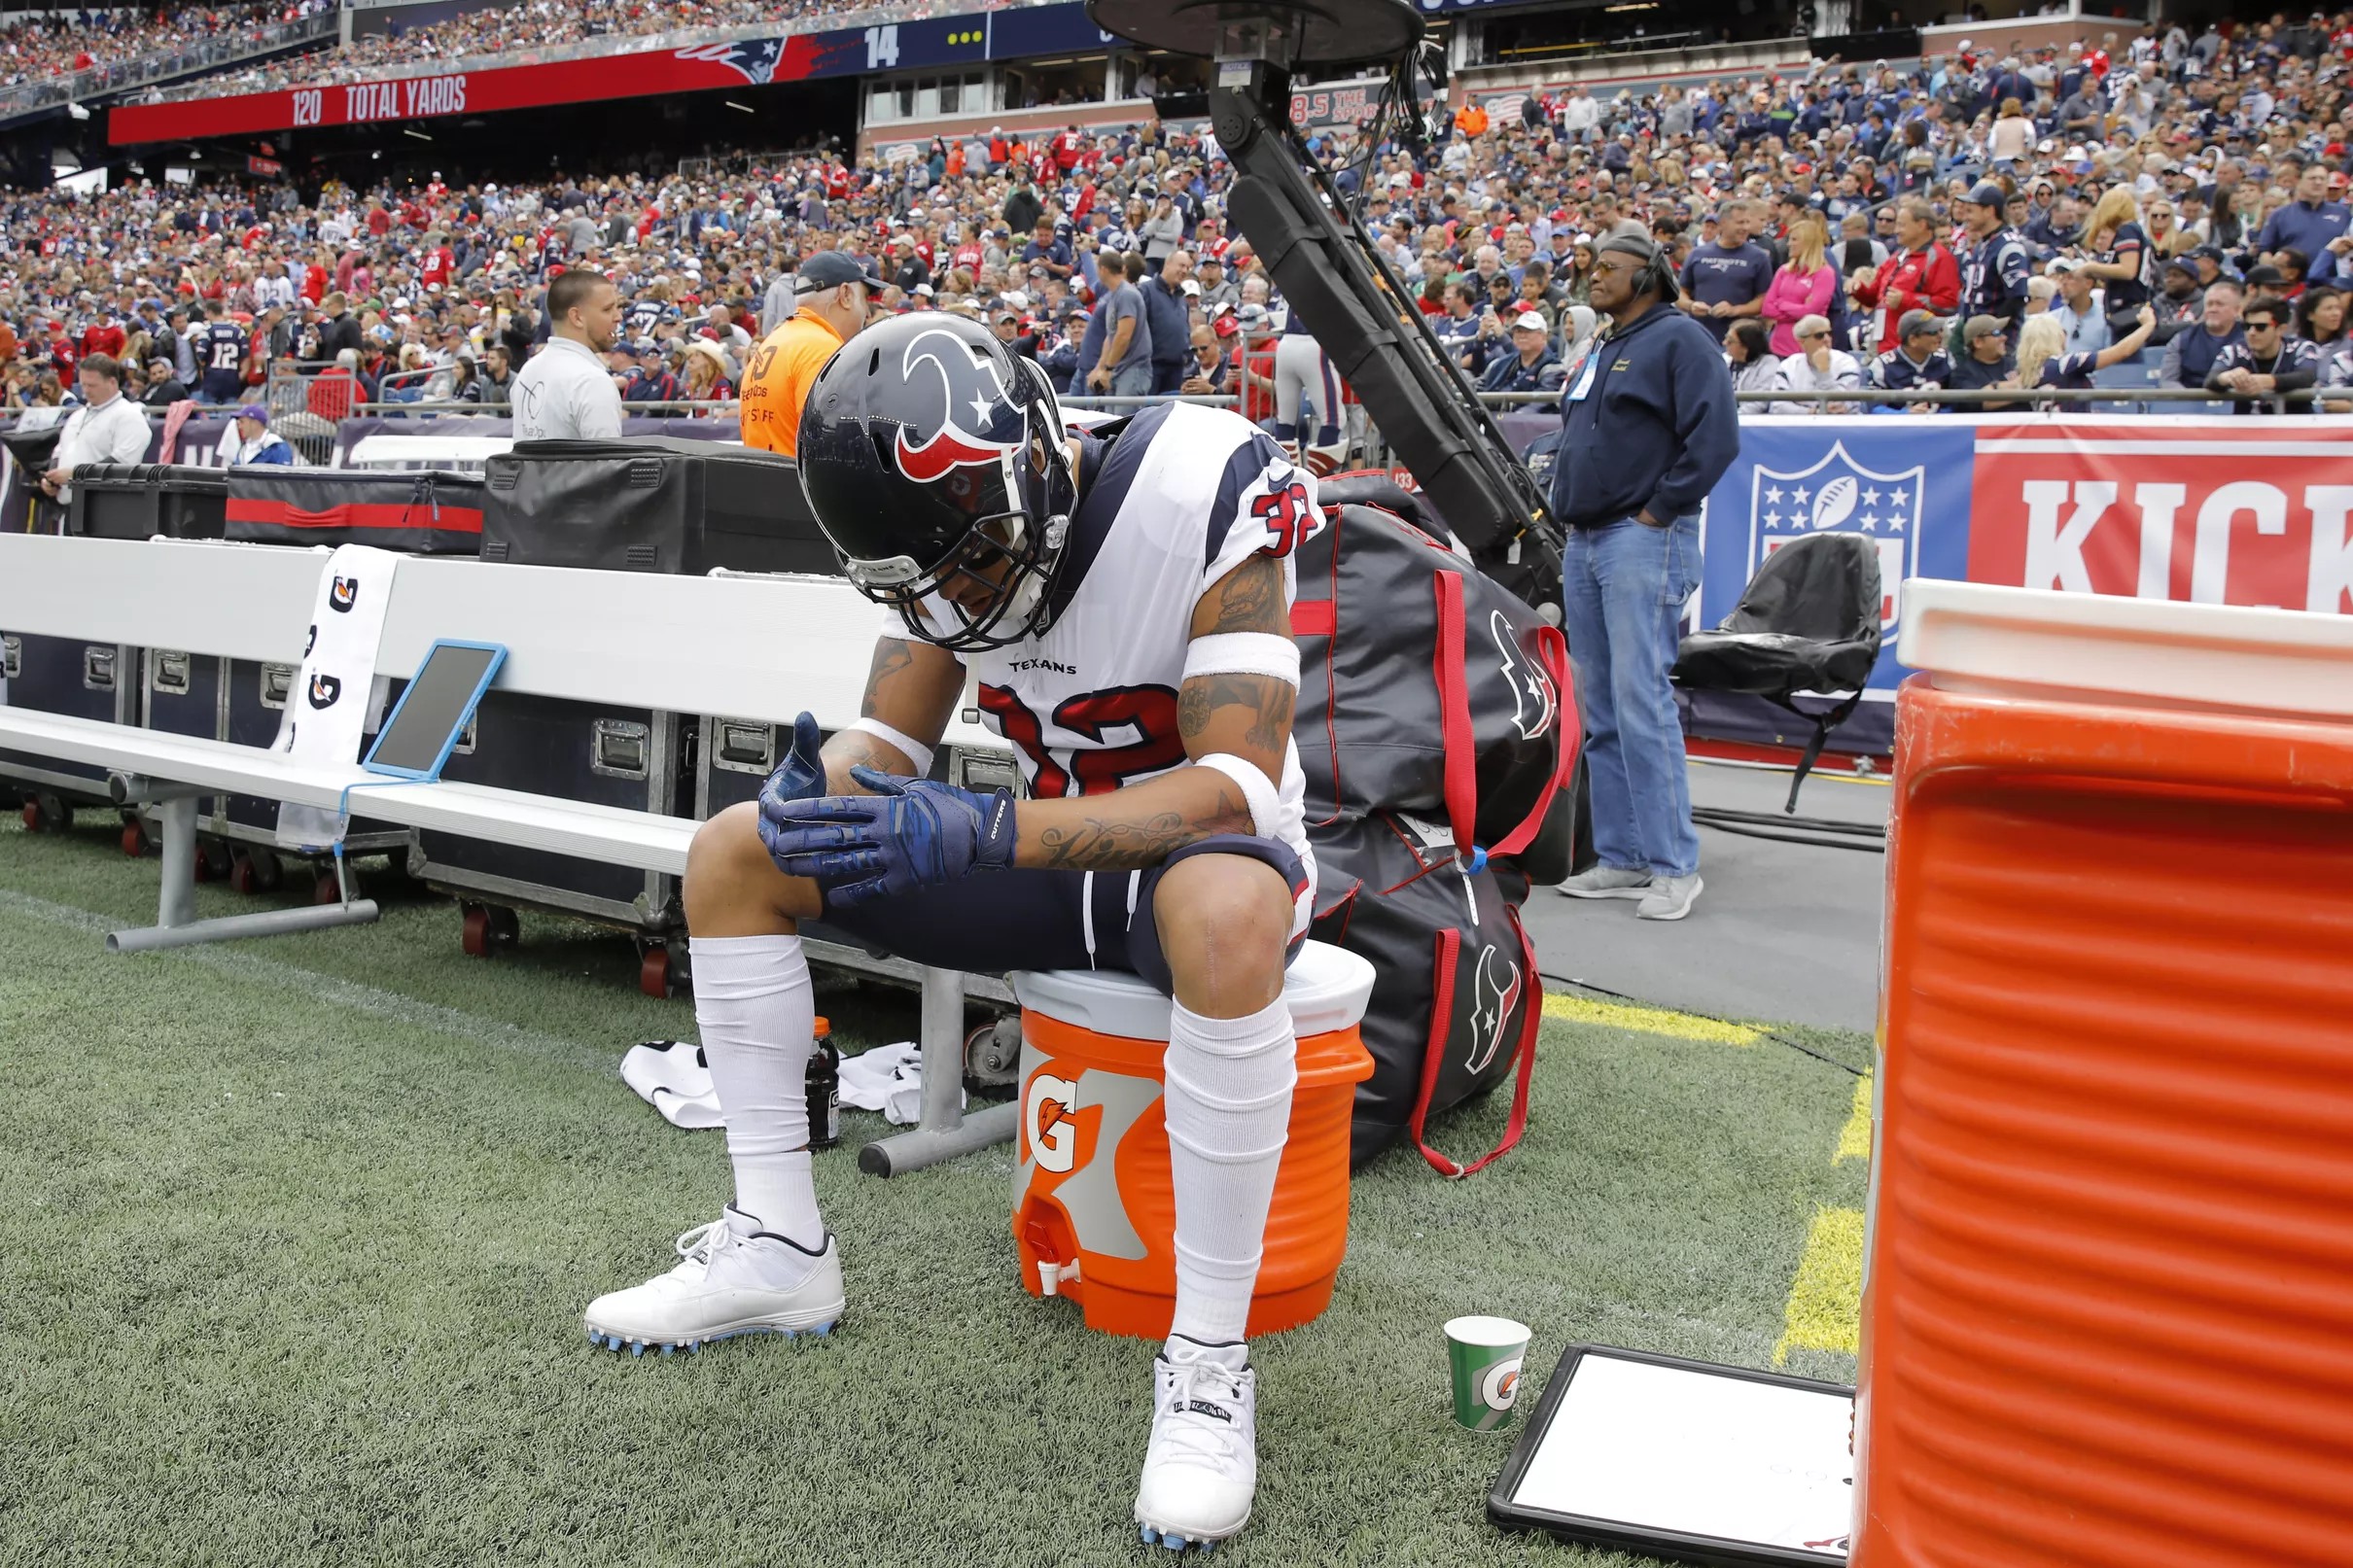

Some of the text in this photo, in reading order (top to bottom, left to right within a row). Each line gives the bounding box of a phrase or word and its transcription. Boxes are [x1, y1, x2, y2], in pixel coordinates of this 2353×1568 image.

[863, 24, 900, 69] 14
[293, 75, 467, 126] 120 TOTAL YARDS
[1332, 88, 1366, 106] THE
[1701, 258, 1748, 266] PATRIOTS
[210, 341, 239, 369] 12
[1395, 472, 1413, 489] 133
[1008, 658, 1077, 675] TEXANS
[991, 798, 1007, 840] CUTTERS
[1027, 1073, 1078, 1173] G
[1481, 1355, 1524, 1411] G
